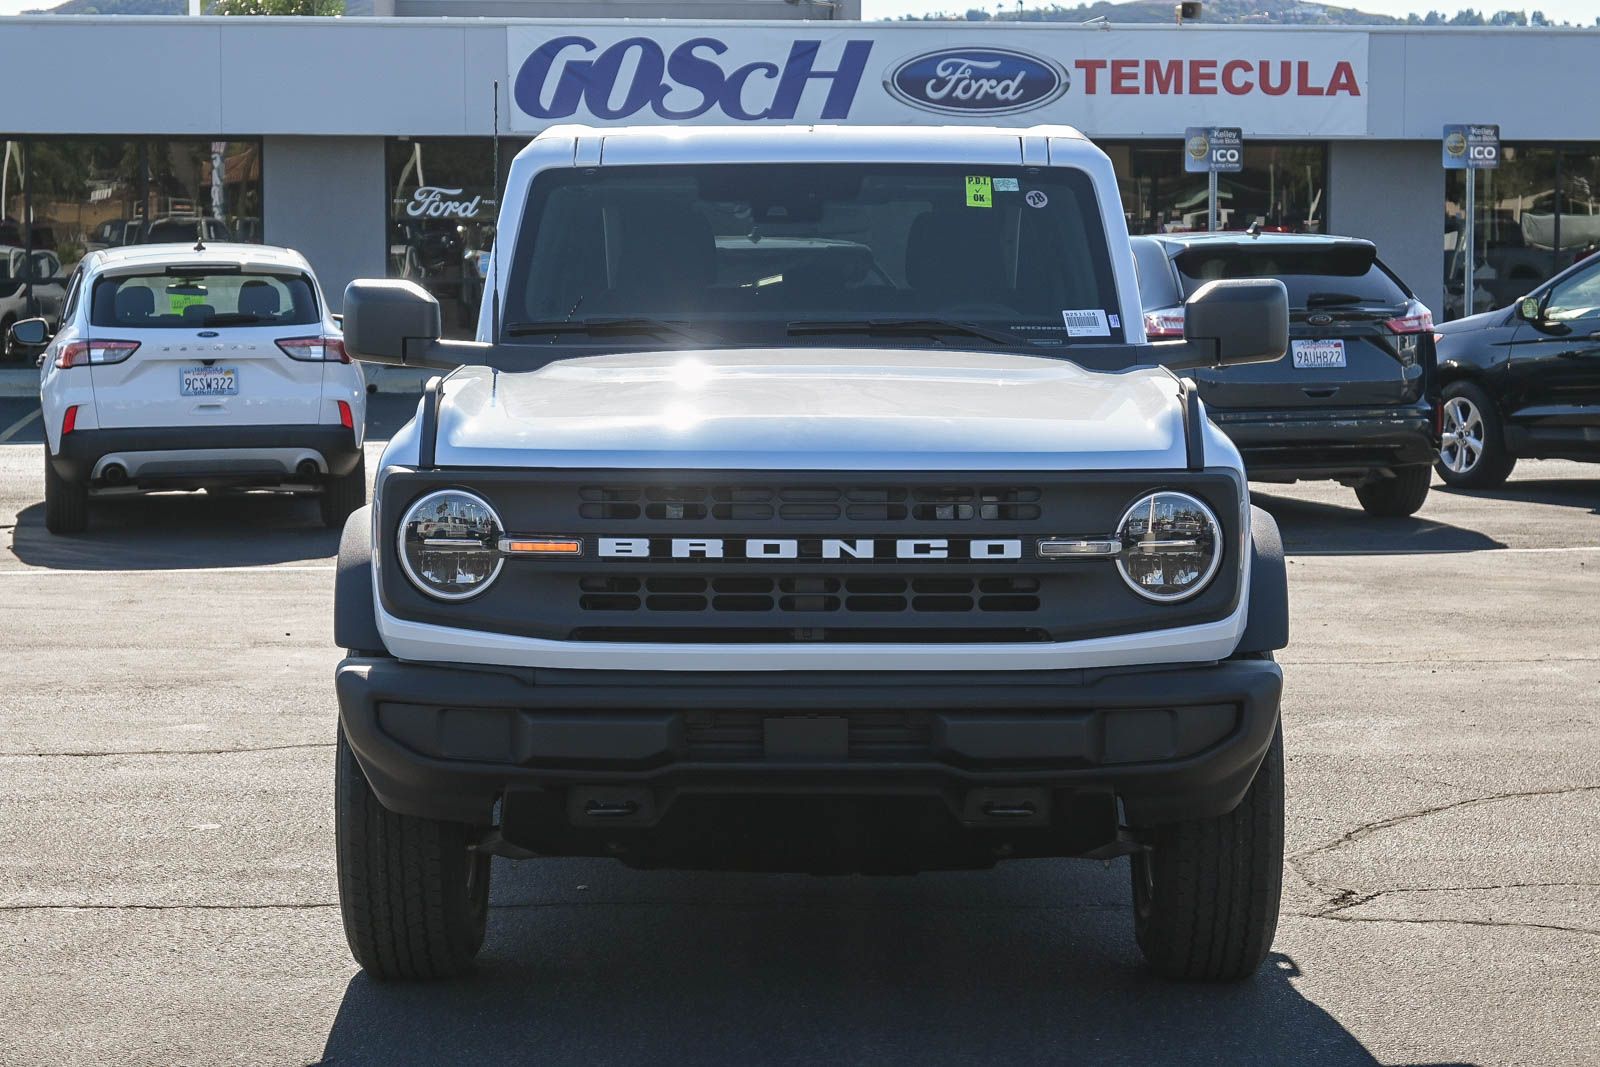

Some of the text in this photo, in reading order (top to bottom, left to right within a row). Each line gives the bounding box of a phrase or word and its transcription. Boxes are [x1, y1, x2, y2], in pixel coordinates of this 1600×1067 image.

[926, 58, 1026, 100] Ford
[1074, 59, 1361, 96] TEMECULA
[1214, 130, 1237, 138] Kelley
[1212, 149, 1239, 162] ICO
[1470, 146, 1496, 159] ICO
[407, 187, 480, 217] Ford
[973, 193, 985, 202] OK
[1028, 192, 1045, 206] 28
[184, 377, 234, 391] 9CSW322
[598, 538, 1022, 558] BRONCO
